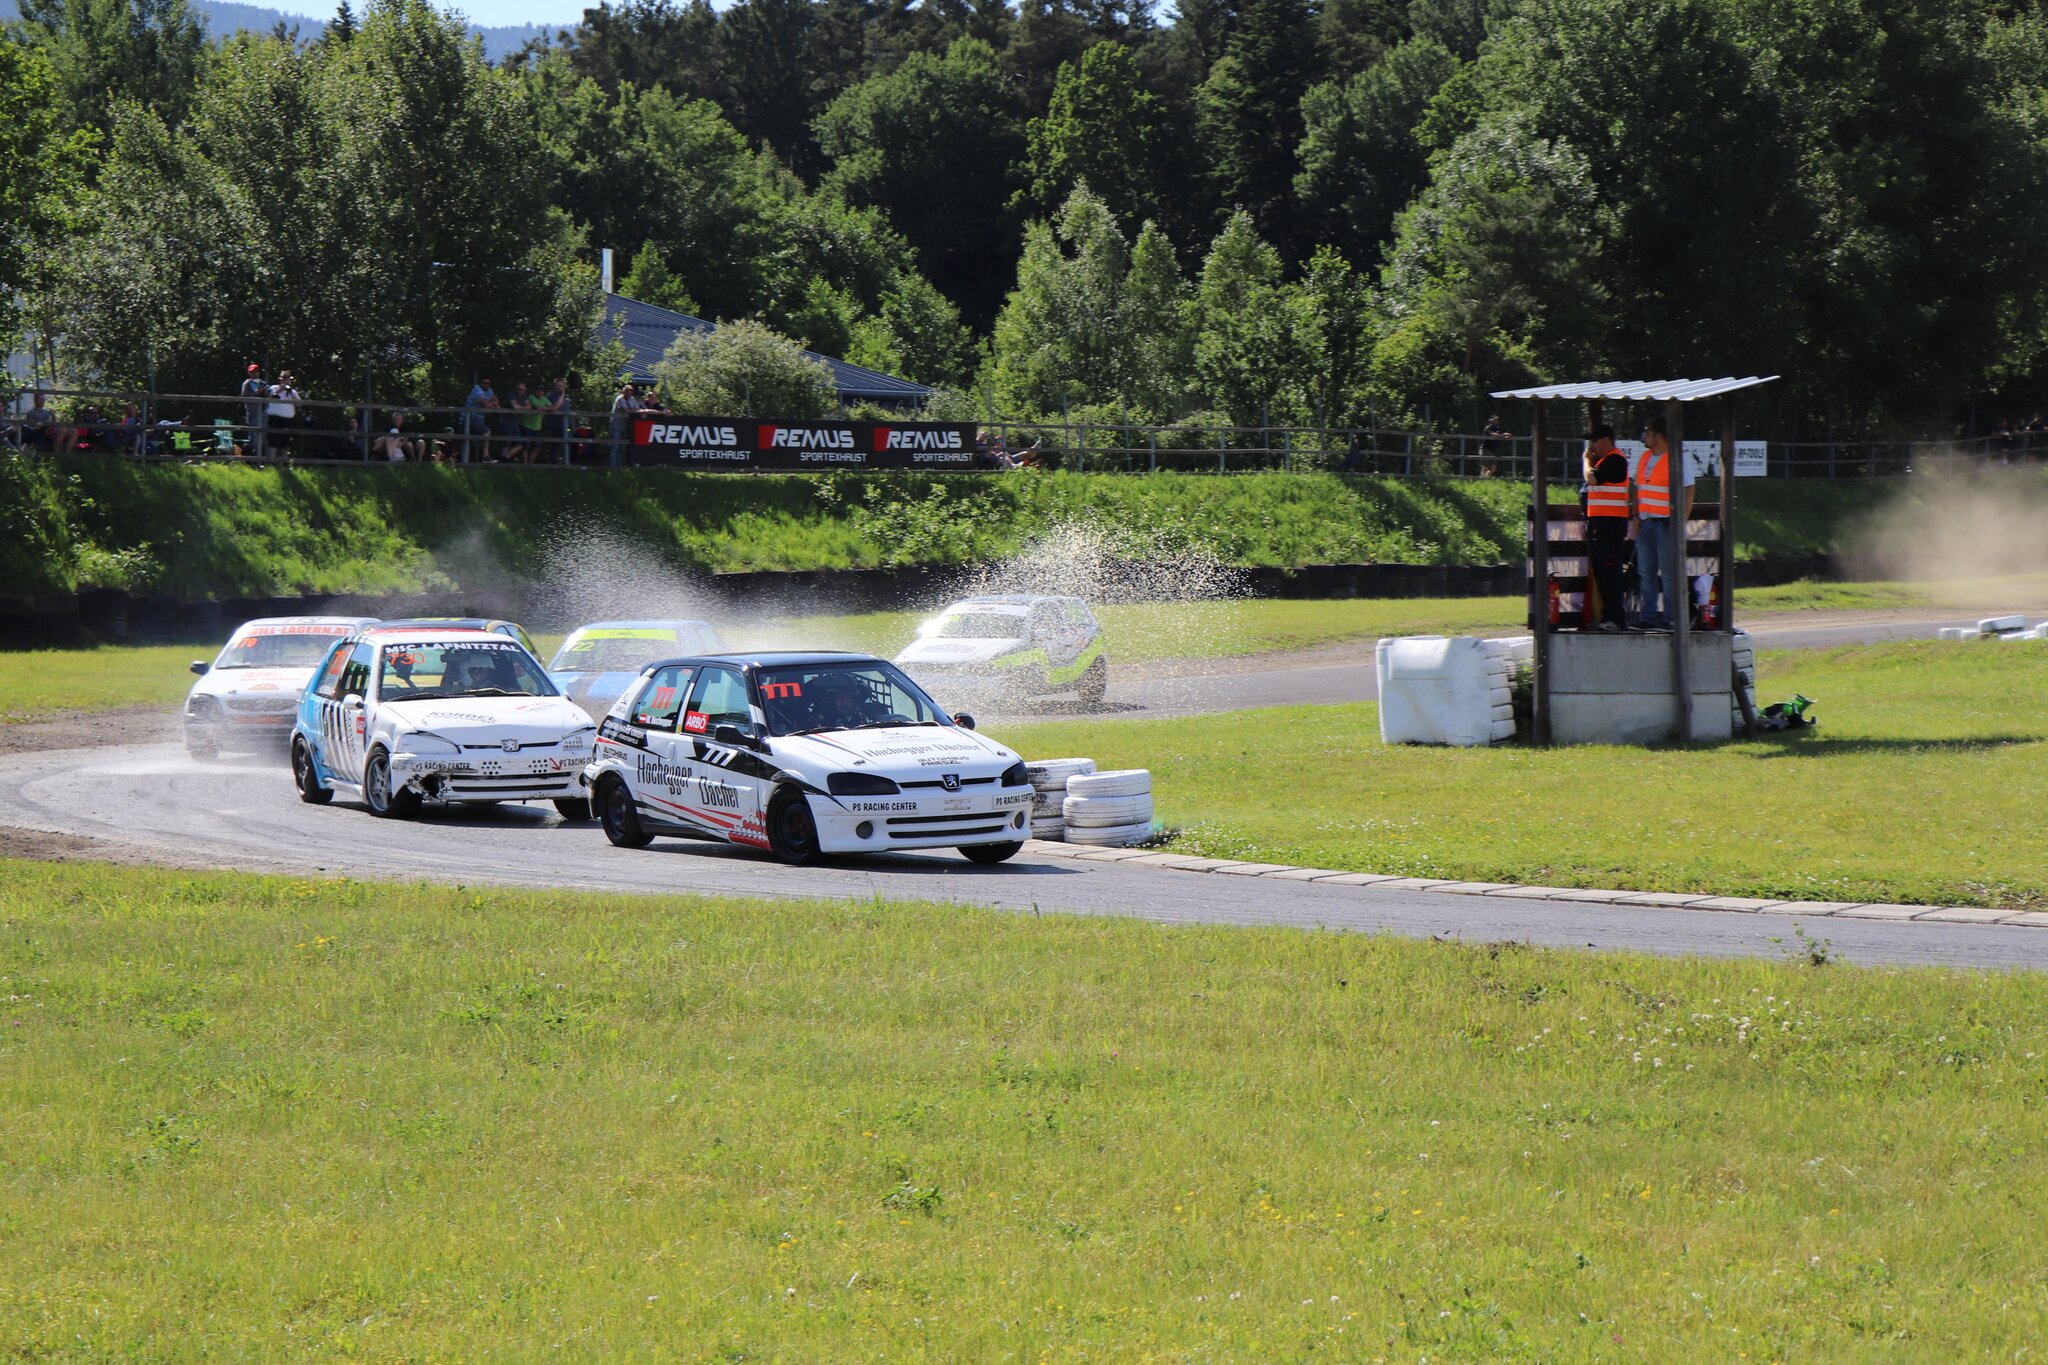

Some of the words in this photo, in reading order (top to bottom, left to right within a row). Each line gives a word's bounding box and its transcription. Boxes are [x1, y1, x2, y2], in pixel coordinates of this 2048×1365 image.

[648, 424, 737, 446] REMUS
[771, 428, 855, 448] REMUS
[886, 431, 962, 449] REMUS
[679, 449, 751, 460] SPORTEXHAUST
[800, 452, 867, 462] SPORTEXHAUST
[913, 453, 973, 462] SPORTEXHAUST
[384, 644, 416, 654] MSC
[422, 642, 521, 653] LAFNITZTAL
[386, 653, 425, 665] 730
[759, 682, 802, 700] 777
[684, 714, 707, 730] ARBÖ
[603, 746, 628, 760] AUTOHAUS
[701, 742, 739, 767] 777
[863, 745, 934, 757] Hochegger
[567, 757, 585, 767] RACING
[637, 754, 693, 795] Hochegger
[699, 776, 740, 808] Dacher
[853, 803, 862, 811] PS
[863, 802, 890, 811] RACING
[891, 801, 918, 811] CENTER
[995, 797, 1003, 806] PS
[1003, 795, 1021, 805] RACING
